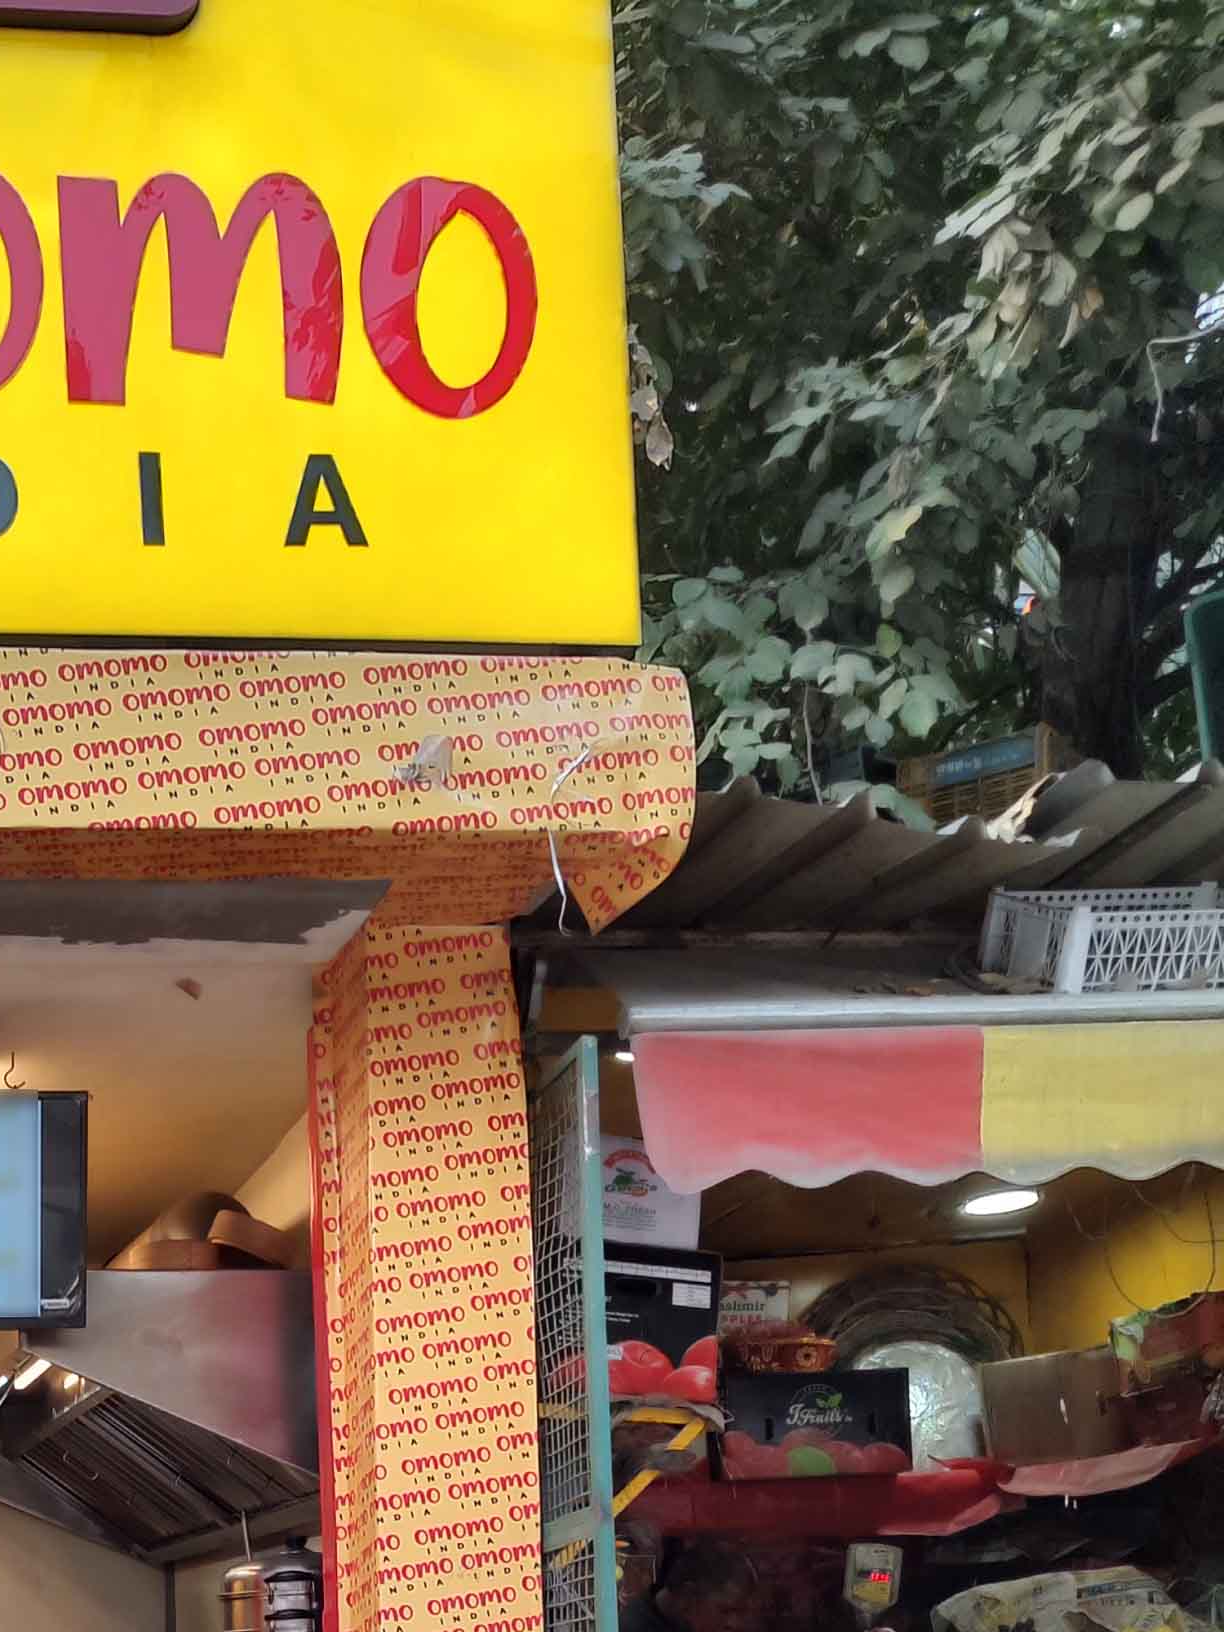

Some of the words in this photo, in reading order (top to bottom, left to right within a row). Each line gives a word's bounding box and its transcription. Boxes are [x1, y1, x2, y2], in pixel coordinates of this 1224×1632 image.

[199, 664, 278, 680] INDIA
[74, 677, 154, 693] INDIA
[378, 681, 455, 696] INDIA
[255, 694, 333, 709] INDIA
[138, 706, 218, 722] INDIA
[443, 708, 519, 725] INDIA
[19, 722, 99, 737] INDIA
[328, 721, 405, 736] INDIA
[214, 742, 293, 757] INDIA
[89, 756, 169, 772] INDIA
[270, 771, 349, 787] INDIA
[154, 785, 233, 800] INDIA
[458, 785, 534, 800] INDIA
[34, 800, 114, 816] INDIA
[343, 797, 420, 813] INDIA
[382, 1075, 450, 1086] INDIA
[396, 1142, 463, 1158] INDIA
[409, 1212, 476, 1228] INDIA
[389, 1328, 454, 1344] INDIA
[401, 1398, 468, 1414] INDIA
[448, 1424, 515, 1436] INDIA
[427, 1540, 494, 1554] INDIA
[440, 1608, 506, 1624] INDIA
